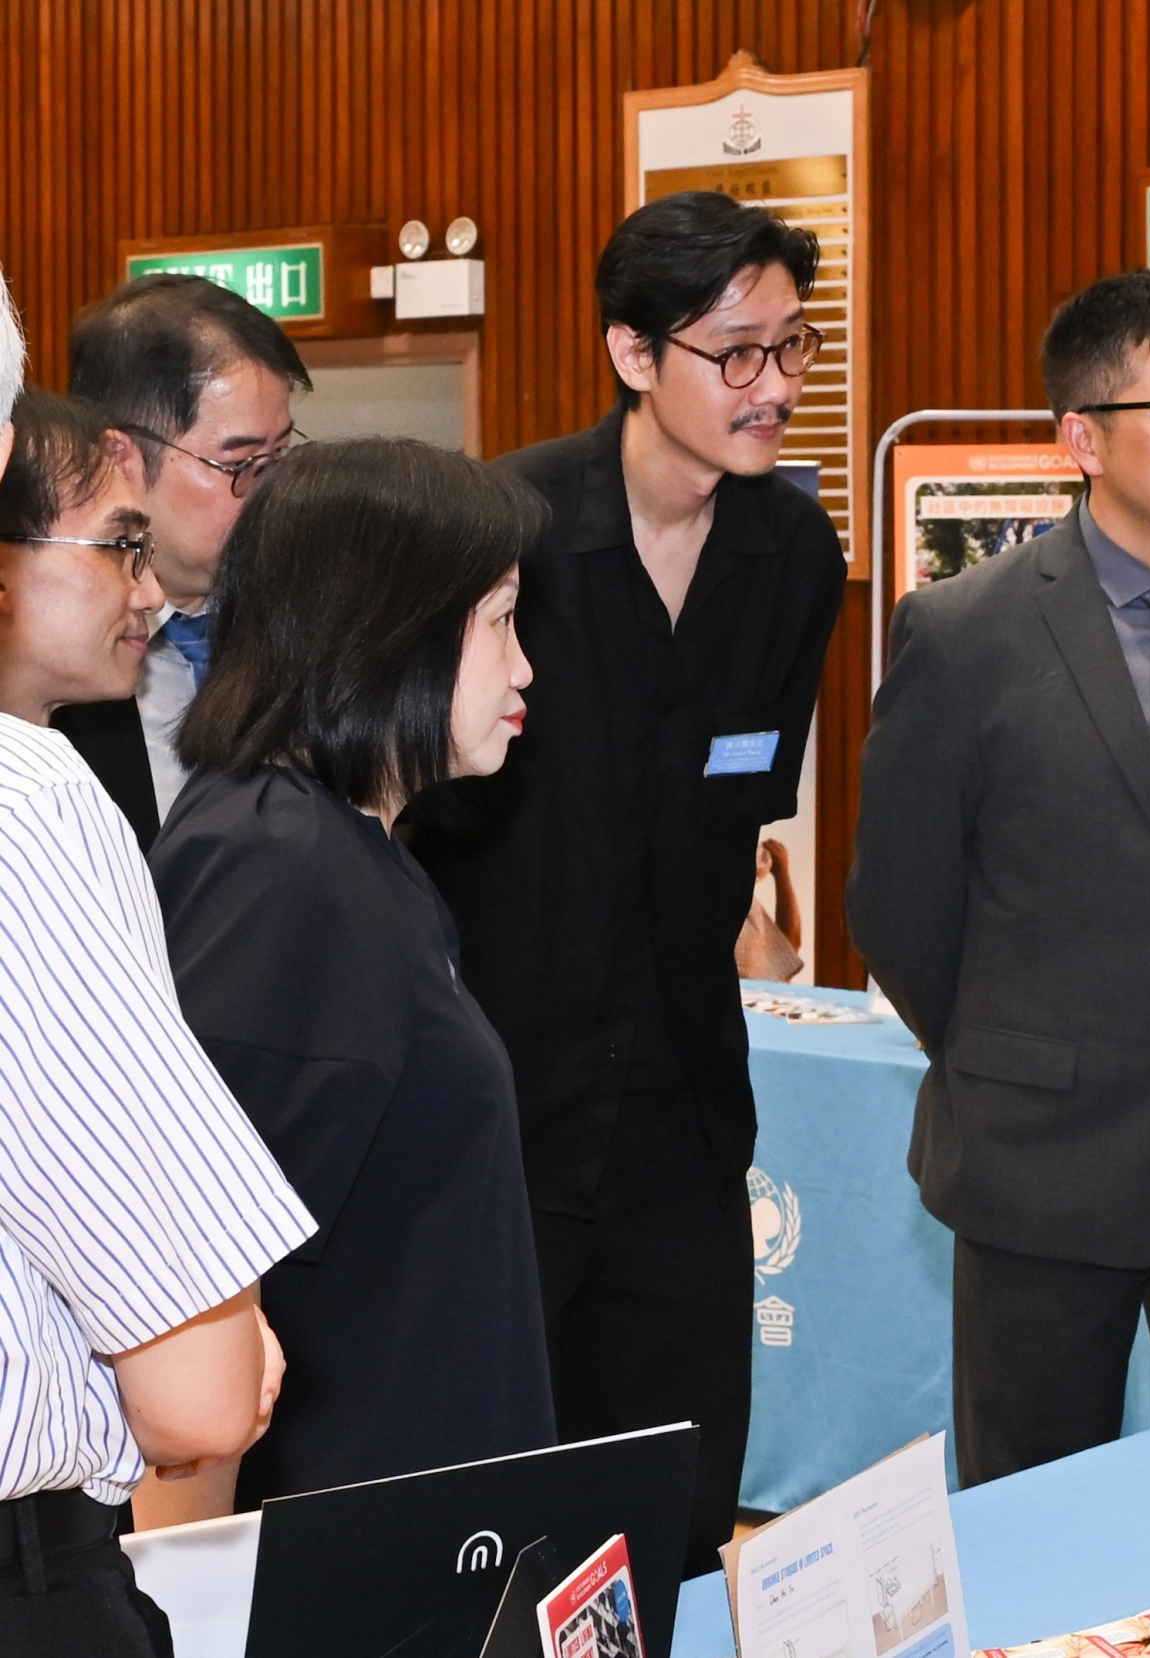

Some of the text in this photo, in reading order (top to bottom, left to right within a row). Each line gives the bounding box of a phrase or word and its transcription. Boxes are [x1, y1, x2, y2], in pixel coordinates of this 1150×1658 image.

[245, 260, 308, 309] 出口
[753, 1294, 796, 1347] 會
[590, 1560, 608, 1587] GOALS
